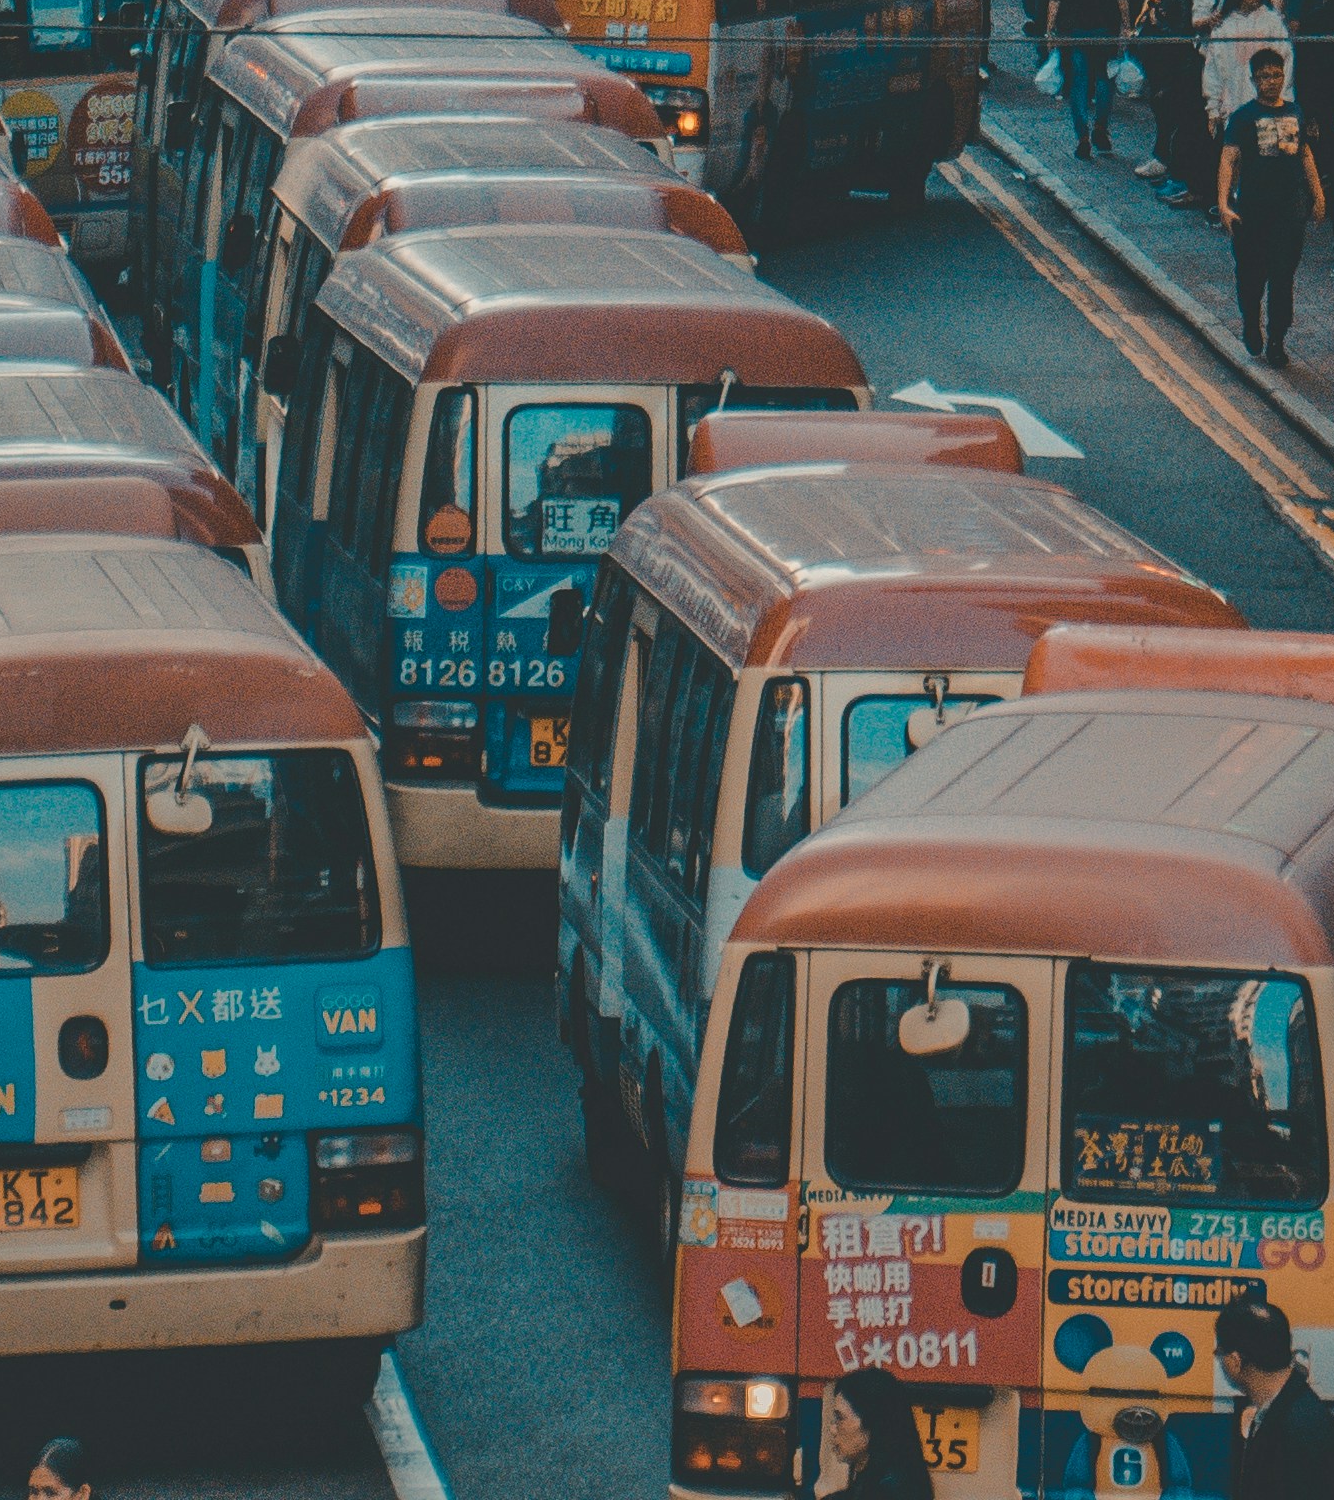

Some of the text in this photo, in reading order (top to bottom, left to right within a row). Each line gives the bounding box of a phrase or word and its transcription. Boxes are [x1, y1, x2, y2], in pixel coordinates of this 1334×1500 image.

[544, 503, 617, 535] 旺角
[502, 577, 536, 593] C&Y
[403, 629, 551, 654] 報稅熱
[399, 657, 566, 689] 8126 8126
[321, 992, 377, 1012] GOGO
[322, 1008, 379, 1036] VAN
[2, 1171, 49, 1200] KT
[1052, 1210, 1168, 1232] MEDIA SAVVY
[1189, 1213, 1325, 1241] 2751 6666
[1256, 1238, 1327, 1273] GO
[826, 1294, 913, 1329] 手機打
[1161, 1346, 1183, 1358] TM
